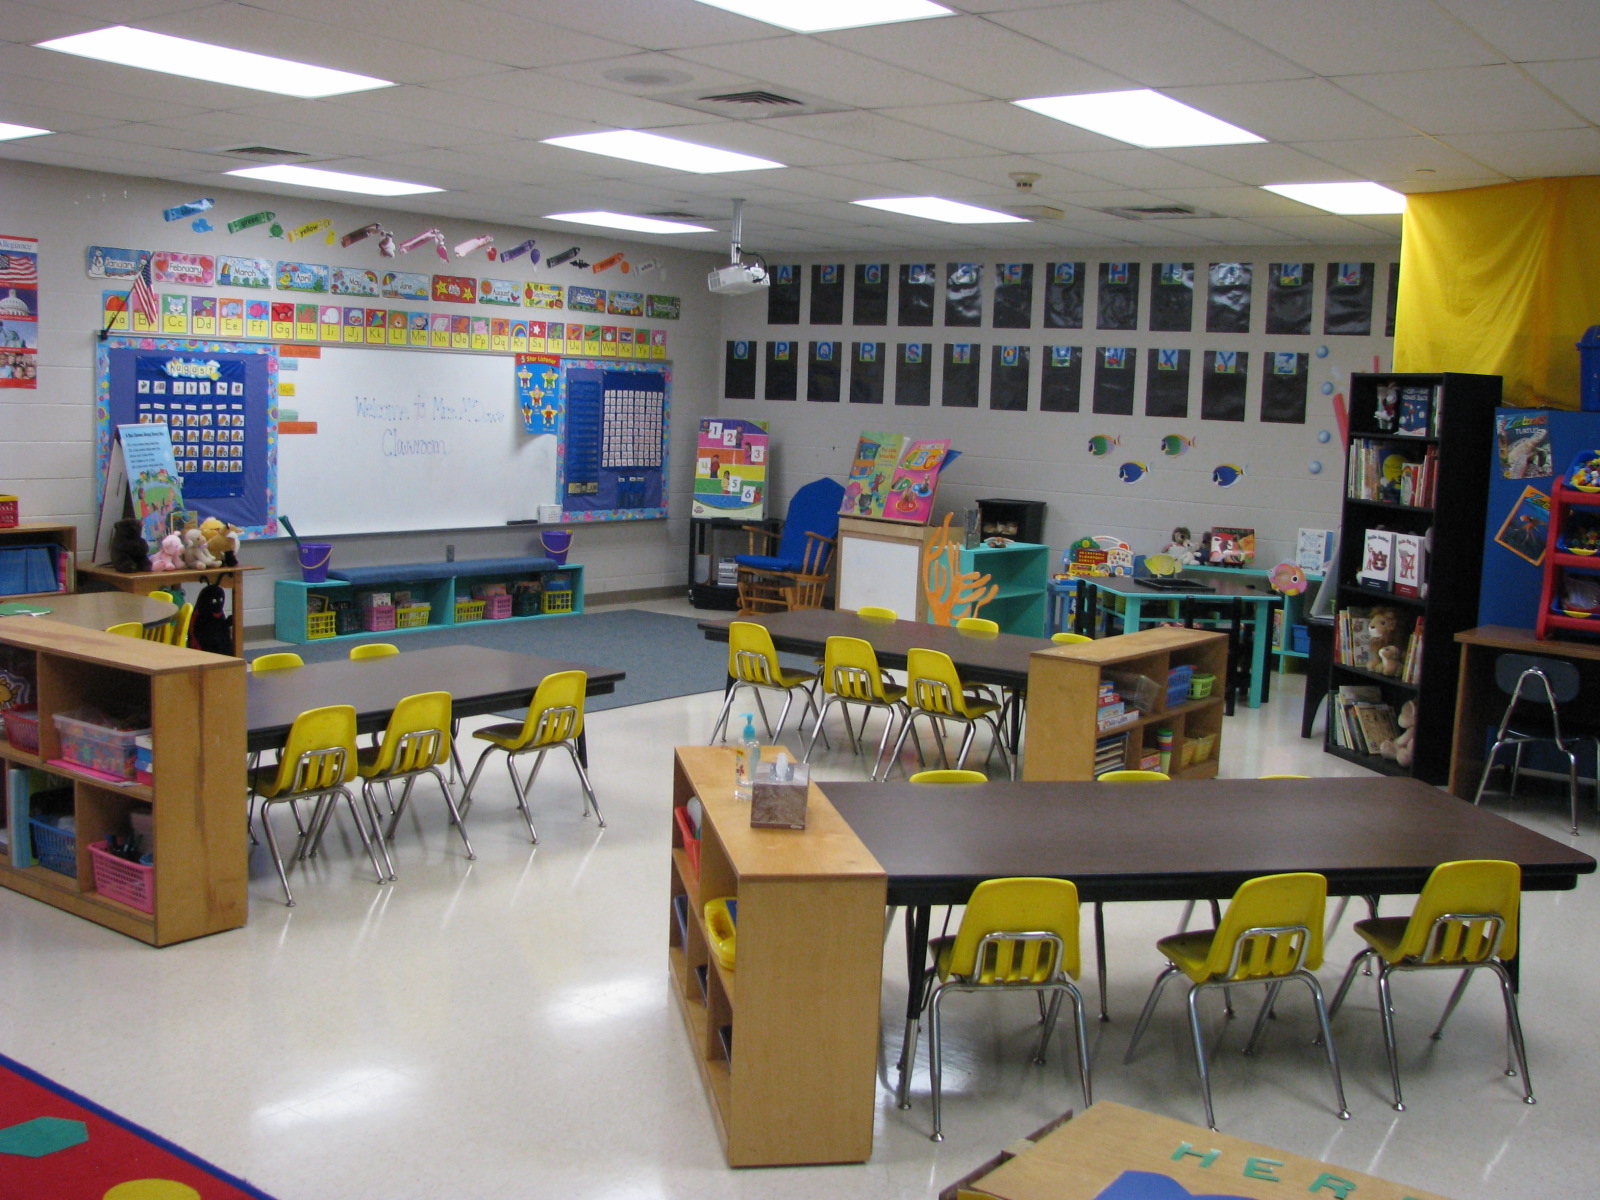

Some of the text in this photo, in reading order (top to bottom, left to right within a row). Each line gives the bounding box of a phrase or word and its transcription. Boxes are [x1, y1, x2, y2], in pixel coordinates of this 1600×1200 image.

[300, 224, 318, 237] yellow
[105, 257, 136, 270] January
[169, 262, 203, 275] February
[234, 267, 257, 277] March
[296, 272, 312, 283] April
[779, 265, 791, 283] A
[866, 265, 879, 283] C
[1056, 264, 1073, 283] G
[1111, 264, 1126, 283] H
[1283, 264, 1300, 284] K
[349, 277, 361, 288] May
[400, 281, 413, 291] June
[493, 289, 511, 299] August
[538, 356, 557, 365] Listener
[861, 343, 875, 361] R
[908, 344, 921, 362] S
[956, 344, 969, 362] T
[1003, 346, 1017, 365] U
[1162, 350, 1176, 369] X
[1219, 351, 1234, 371] Y
[1278, 353, 1295, 374] Z
[170, 362, 214, 377] August
